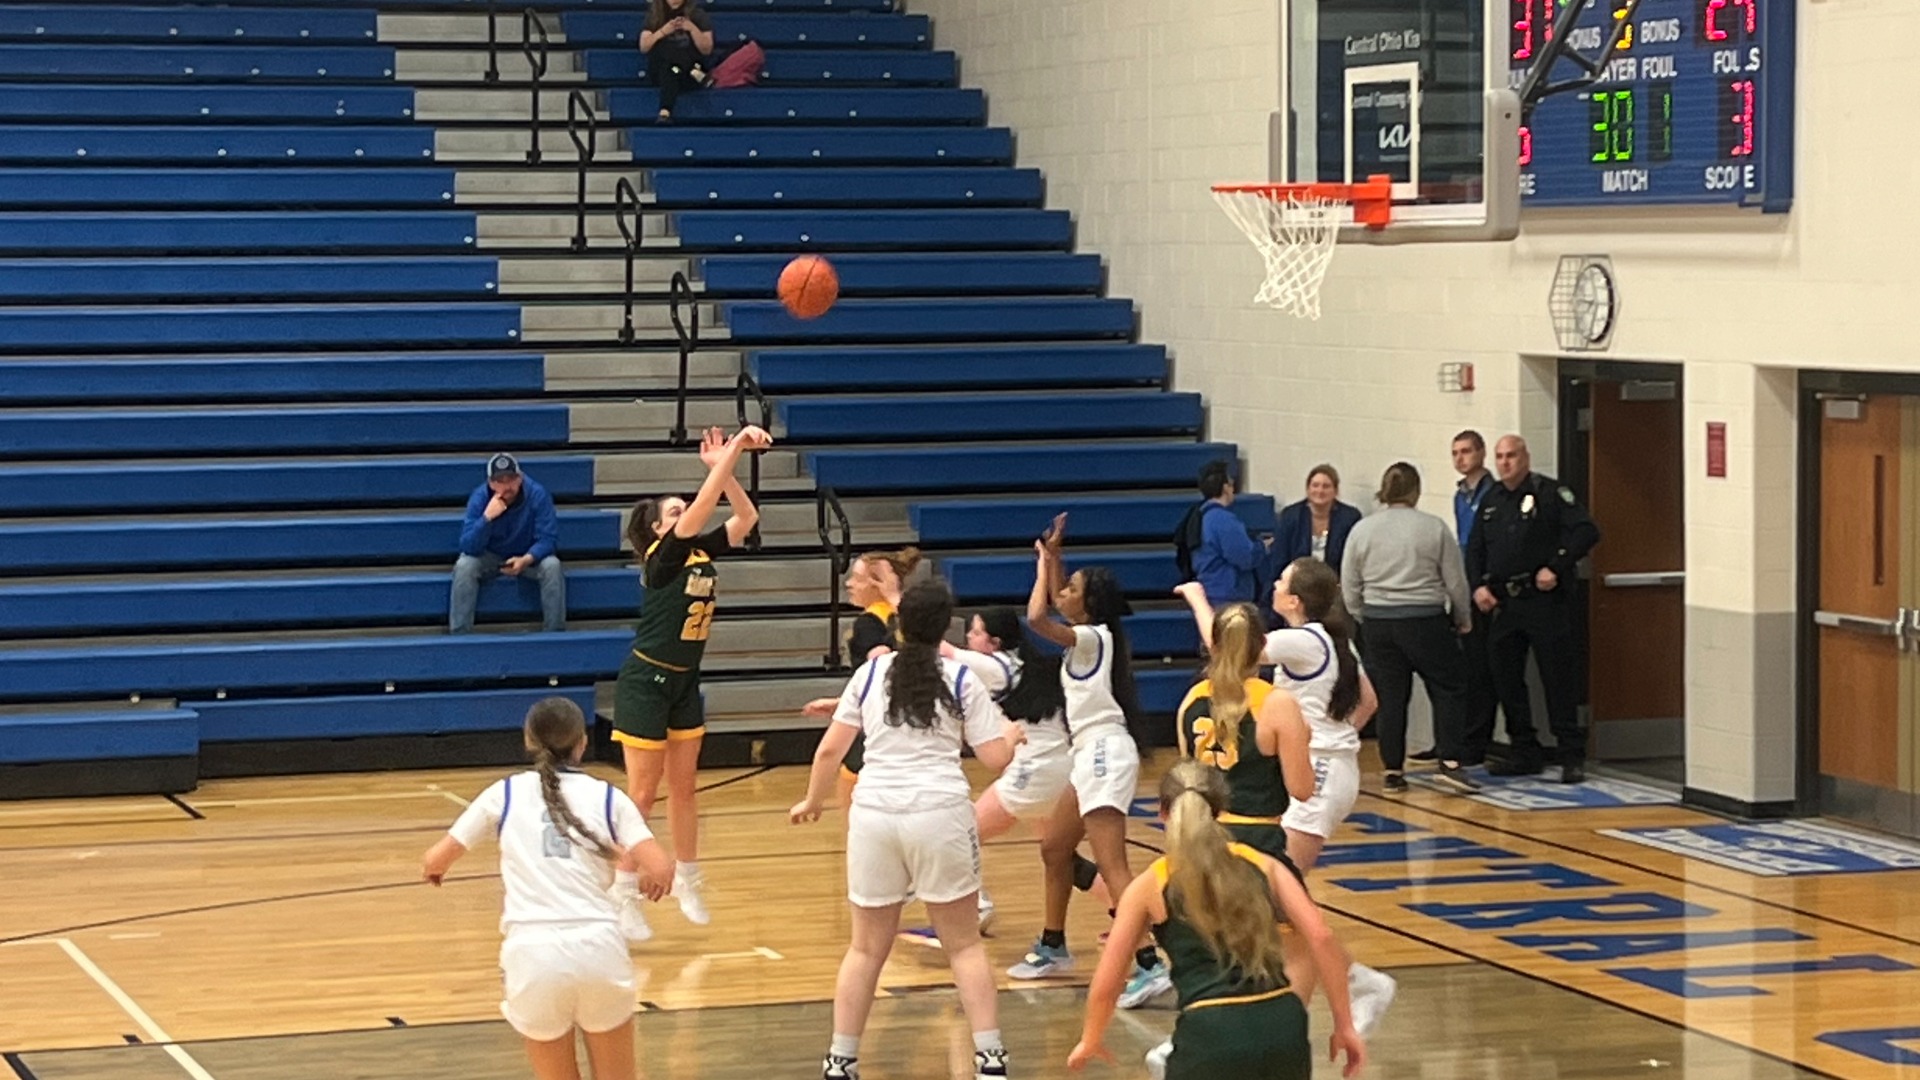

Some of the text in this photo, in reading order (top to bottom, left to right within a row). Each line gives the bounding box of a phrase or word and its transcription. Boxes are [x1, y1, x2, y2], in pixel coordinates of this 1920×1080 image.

[1344, 28, 1420, 55] Central Ohio Kia
[1566, 26, 1601, 50] ONUS
[1641, 18, 1680, 44] BONUS
[1641, 55, 1678, 81] FOUL
[1592, 89, 1635, 162] 30
[1731, 80, 1754, 156] 3
[1602, 169, 1649, 193] MATCH
